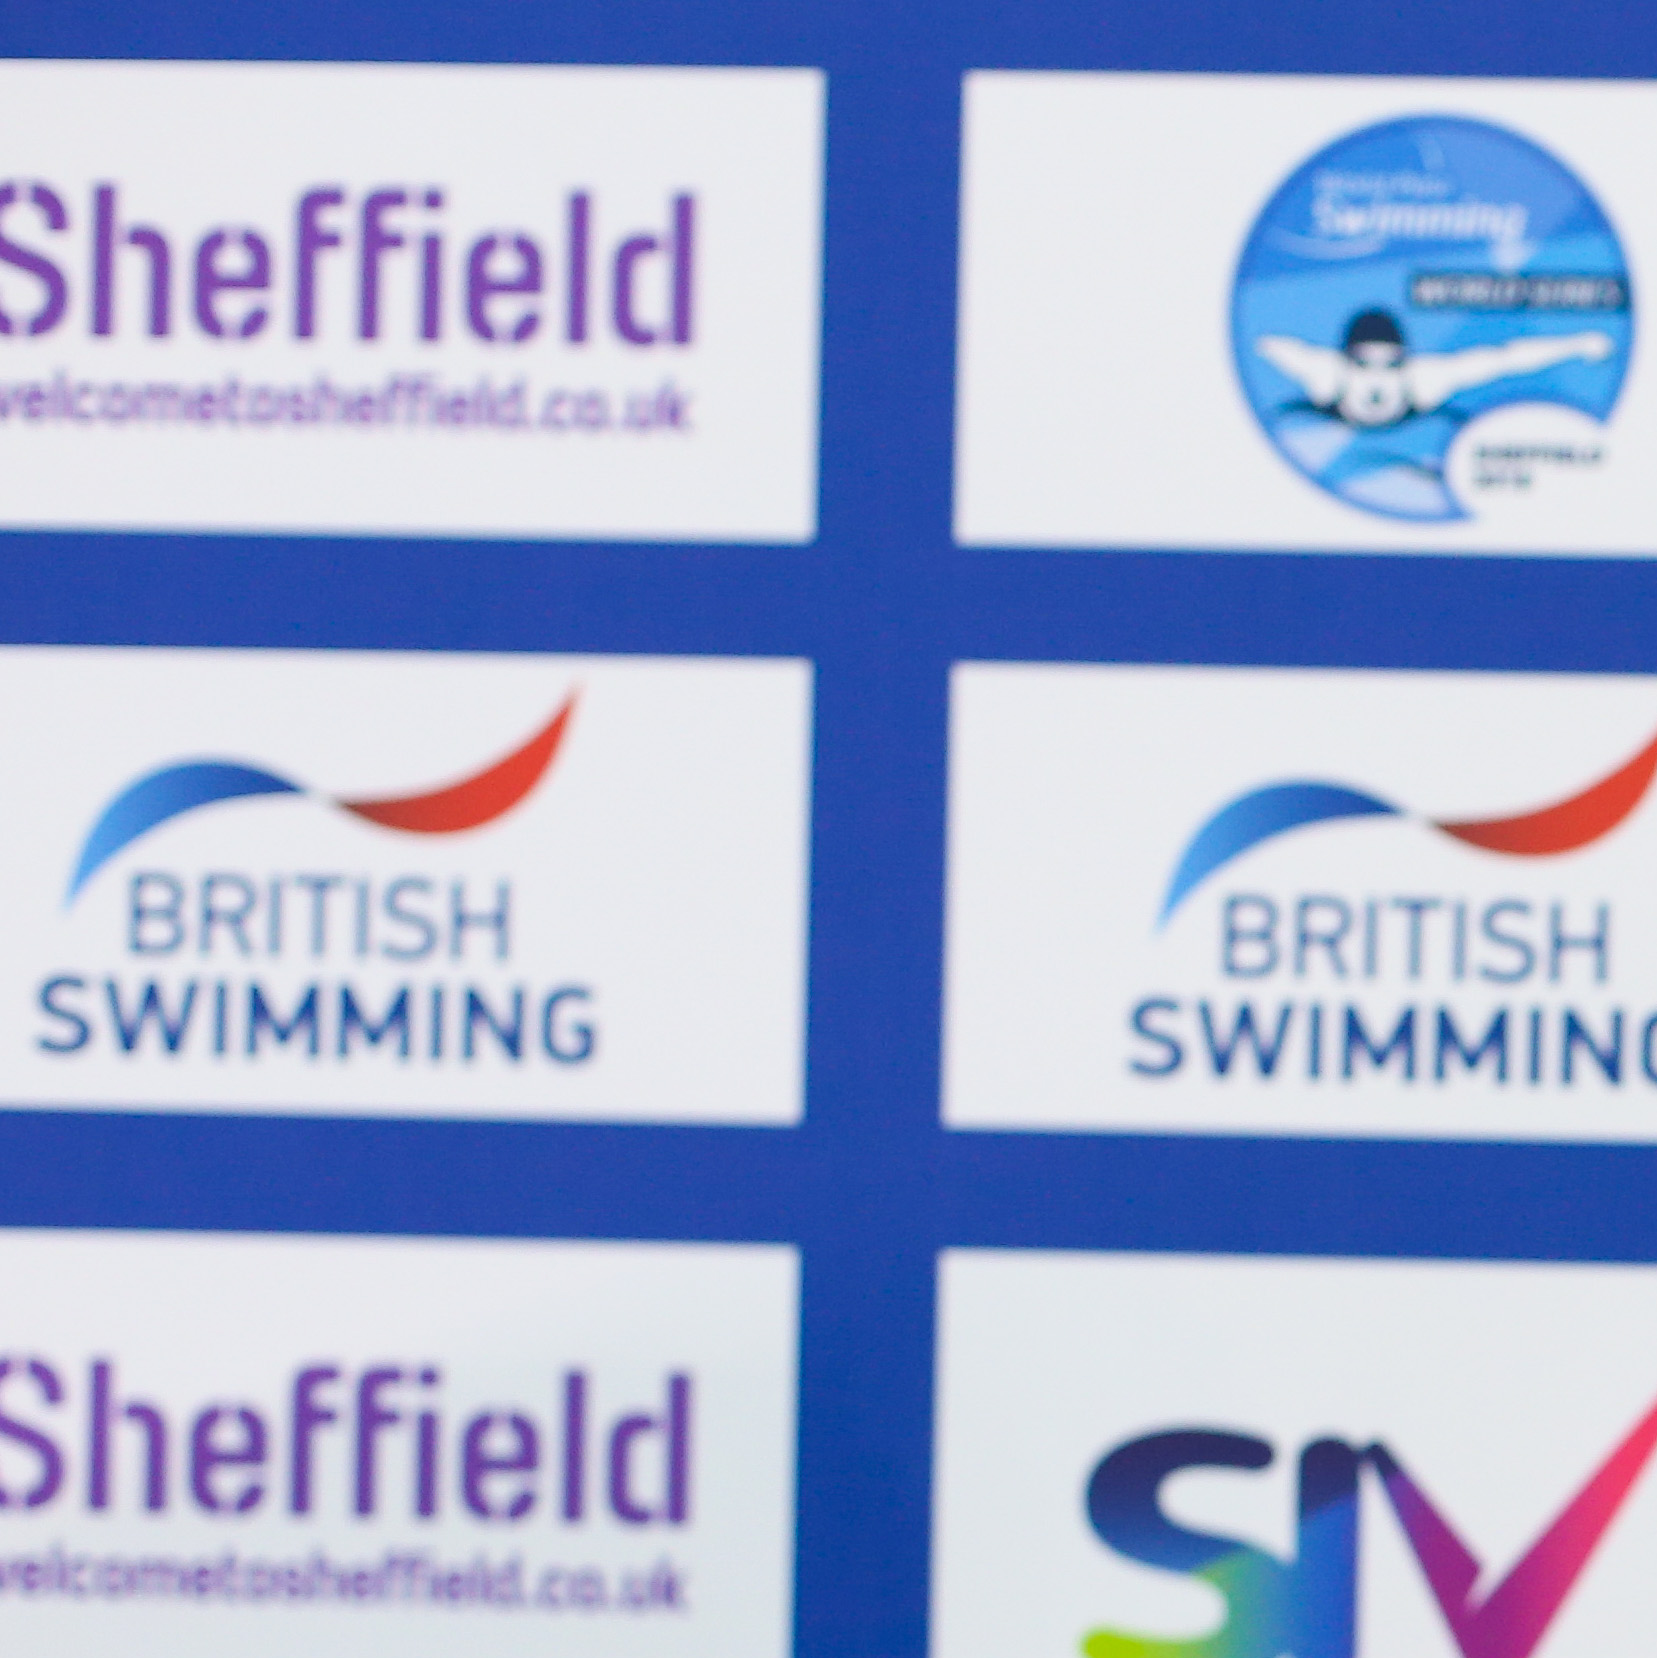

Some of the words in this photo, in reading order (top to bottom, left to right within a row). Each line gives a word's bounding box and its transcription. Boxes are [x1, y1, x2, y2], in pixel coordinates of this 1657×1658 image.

[0, 180, 697, 345] Sheffield
[126, 871, 510, 960] BRITISH
[1220, 893, 1610, 984] BRITISH
[38, 975, 595, 1065] SWIMMING
[0, 1356, 693, 1525] Sheffield
